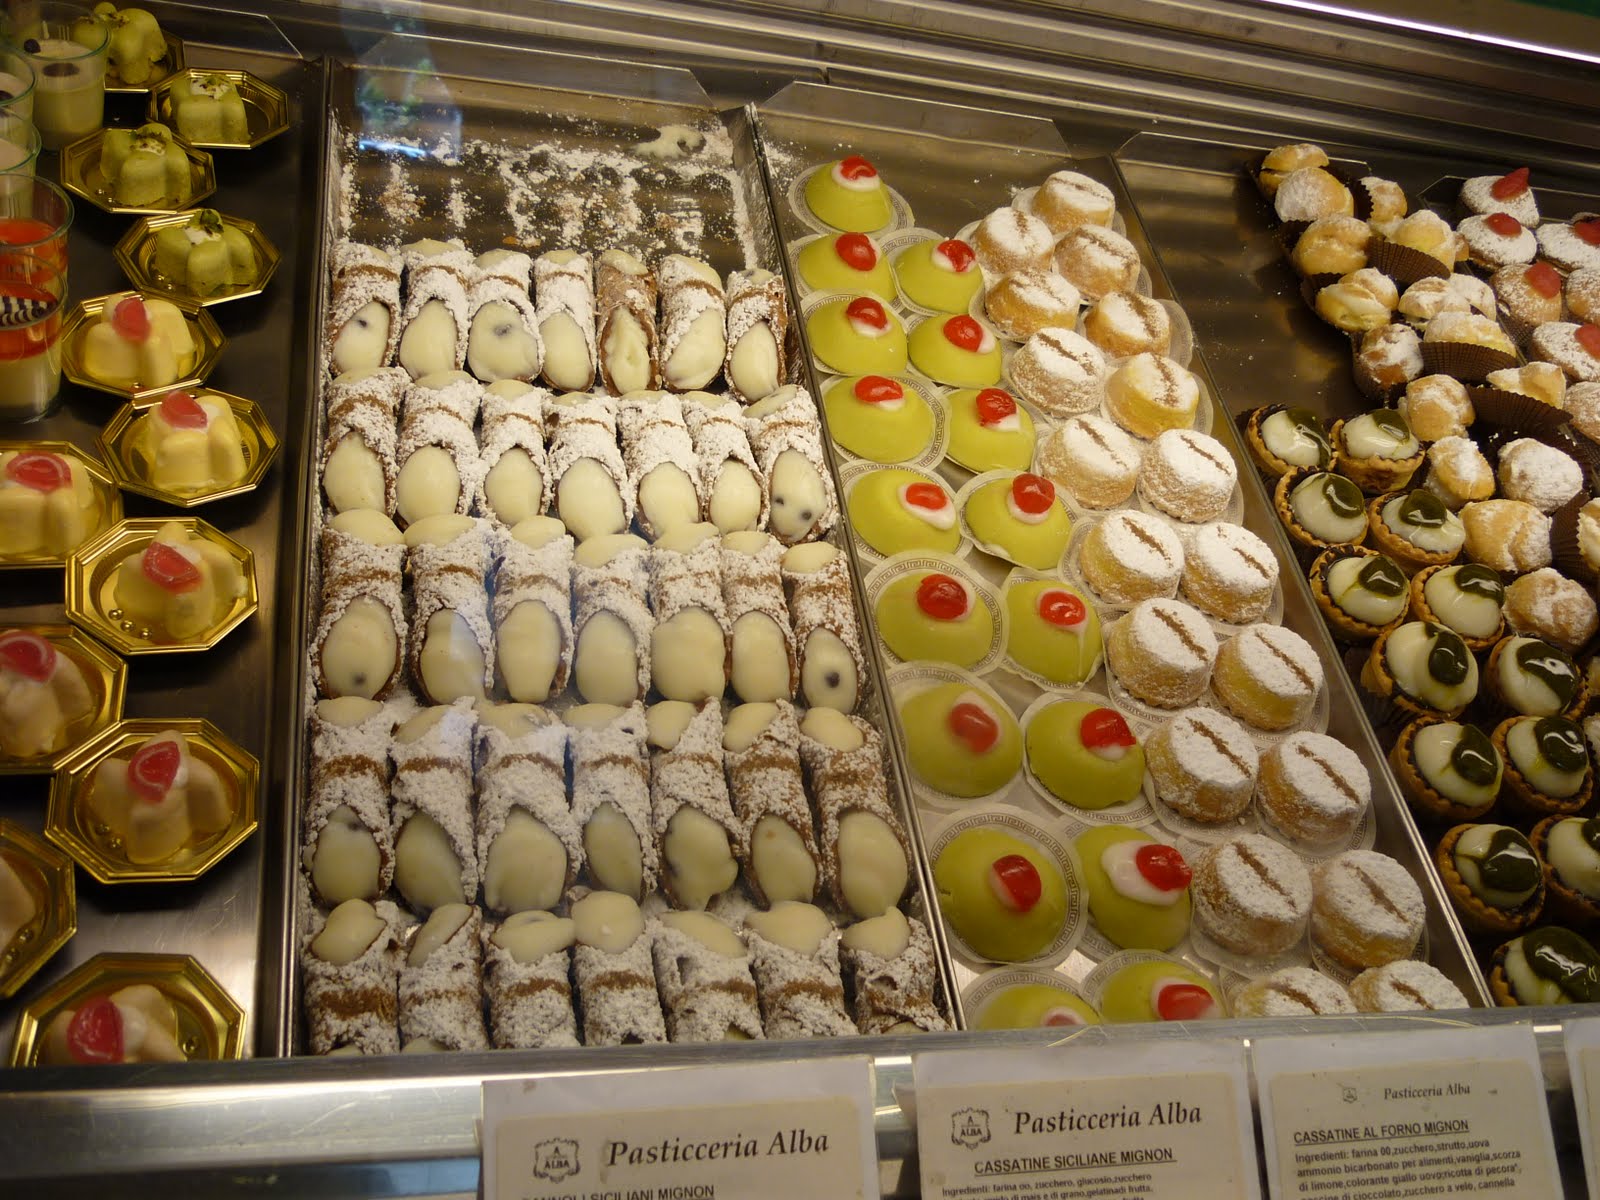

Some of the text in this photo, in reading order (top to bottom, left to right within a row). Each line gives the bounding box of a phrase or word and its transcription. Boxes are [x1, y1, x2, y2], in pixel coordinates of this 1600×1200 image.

[1384, 1082, 1471, 1100] Pasticceria Alba
[1013, 1101, 1202, 1135] Pasticceria Alba
[961, 1128, 982, 1137] ALBA
[1293, 1119, 1469, 1144] CASSATINE AL FORNO MIGNON
[607, 1129, 829, 1167] Pasticceria Alba
[1295, 1148, 1350, 1165] Ingredienti:
[545, 1160, 570, 1169] ALBA
[974, 1148, 1173, 1174] CASSATINE SICILIANE MIGNON
[1297, 1165, 1342, 1177] ammonio
[1344, 1160, 1400, 1174] bicarbonato
[1402, 1160, 1417, 1170] per
[1299, 1182, 1308, 1192] di
[1392, 1171, 1417, 1185] giallo
[1475, 1166, 1484, 1176] di
[1447, 1185, 1453, 1193] a
[1478, 1178, 1516, 1190] cannella
[658, 1181, 714, 1200] MIGNON
[942, 1185, 991, 1198] Ingredienti:
